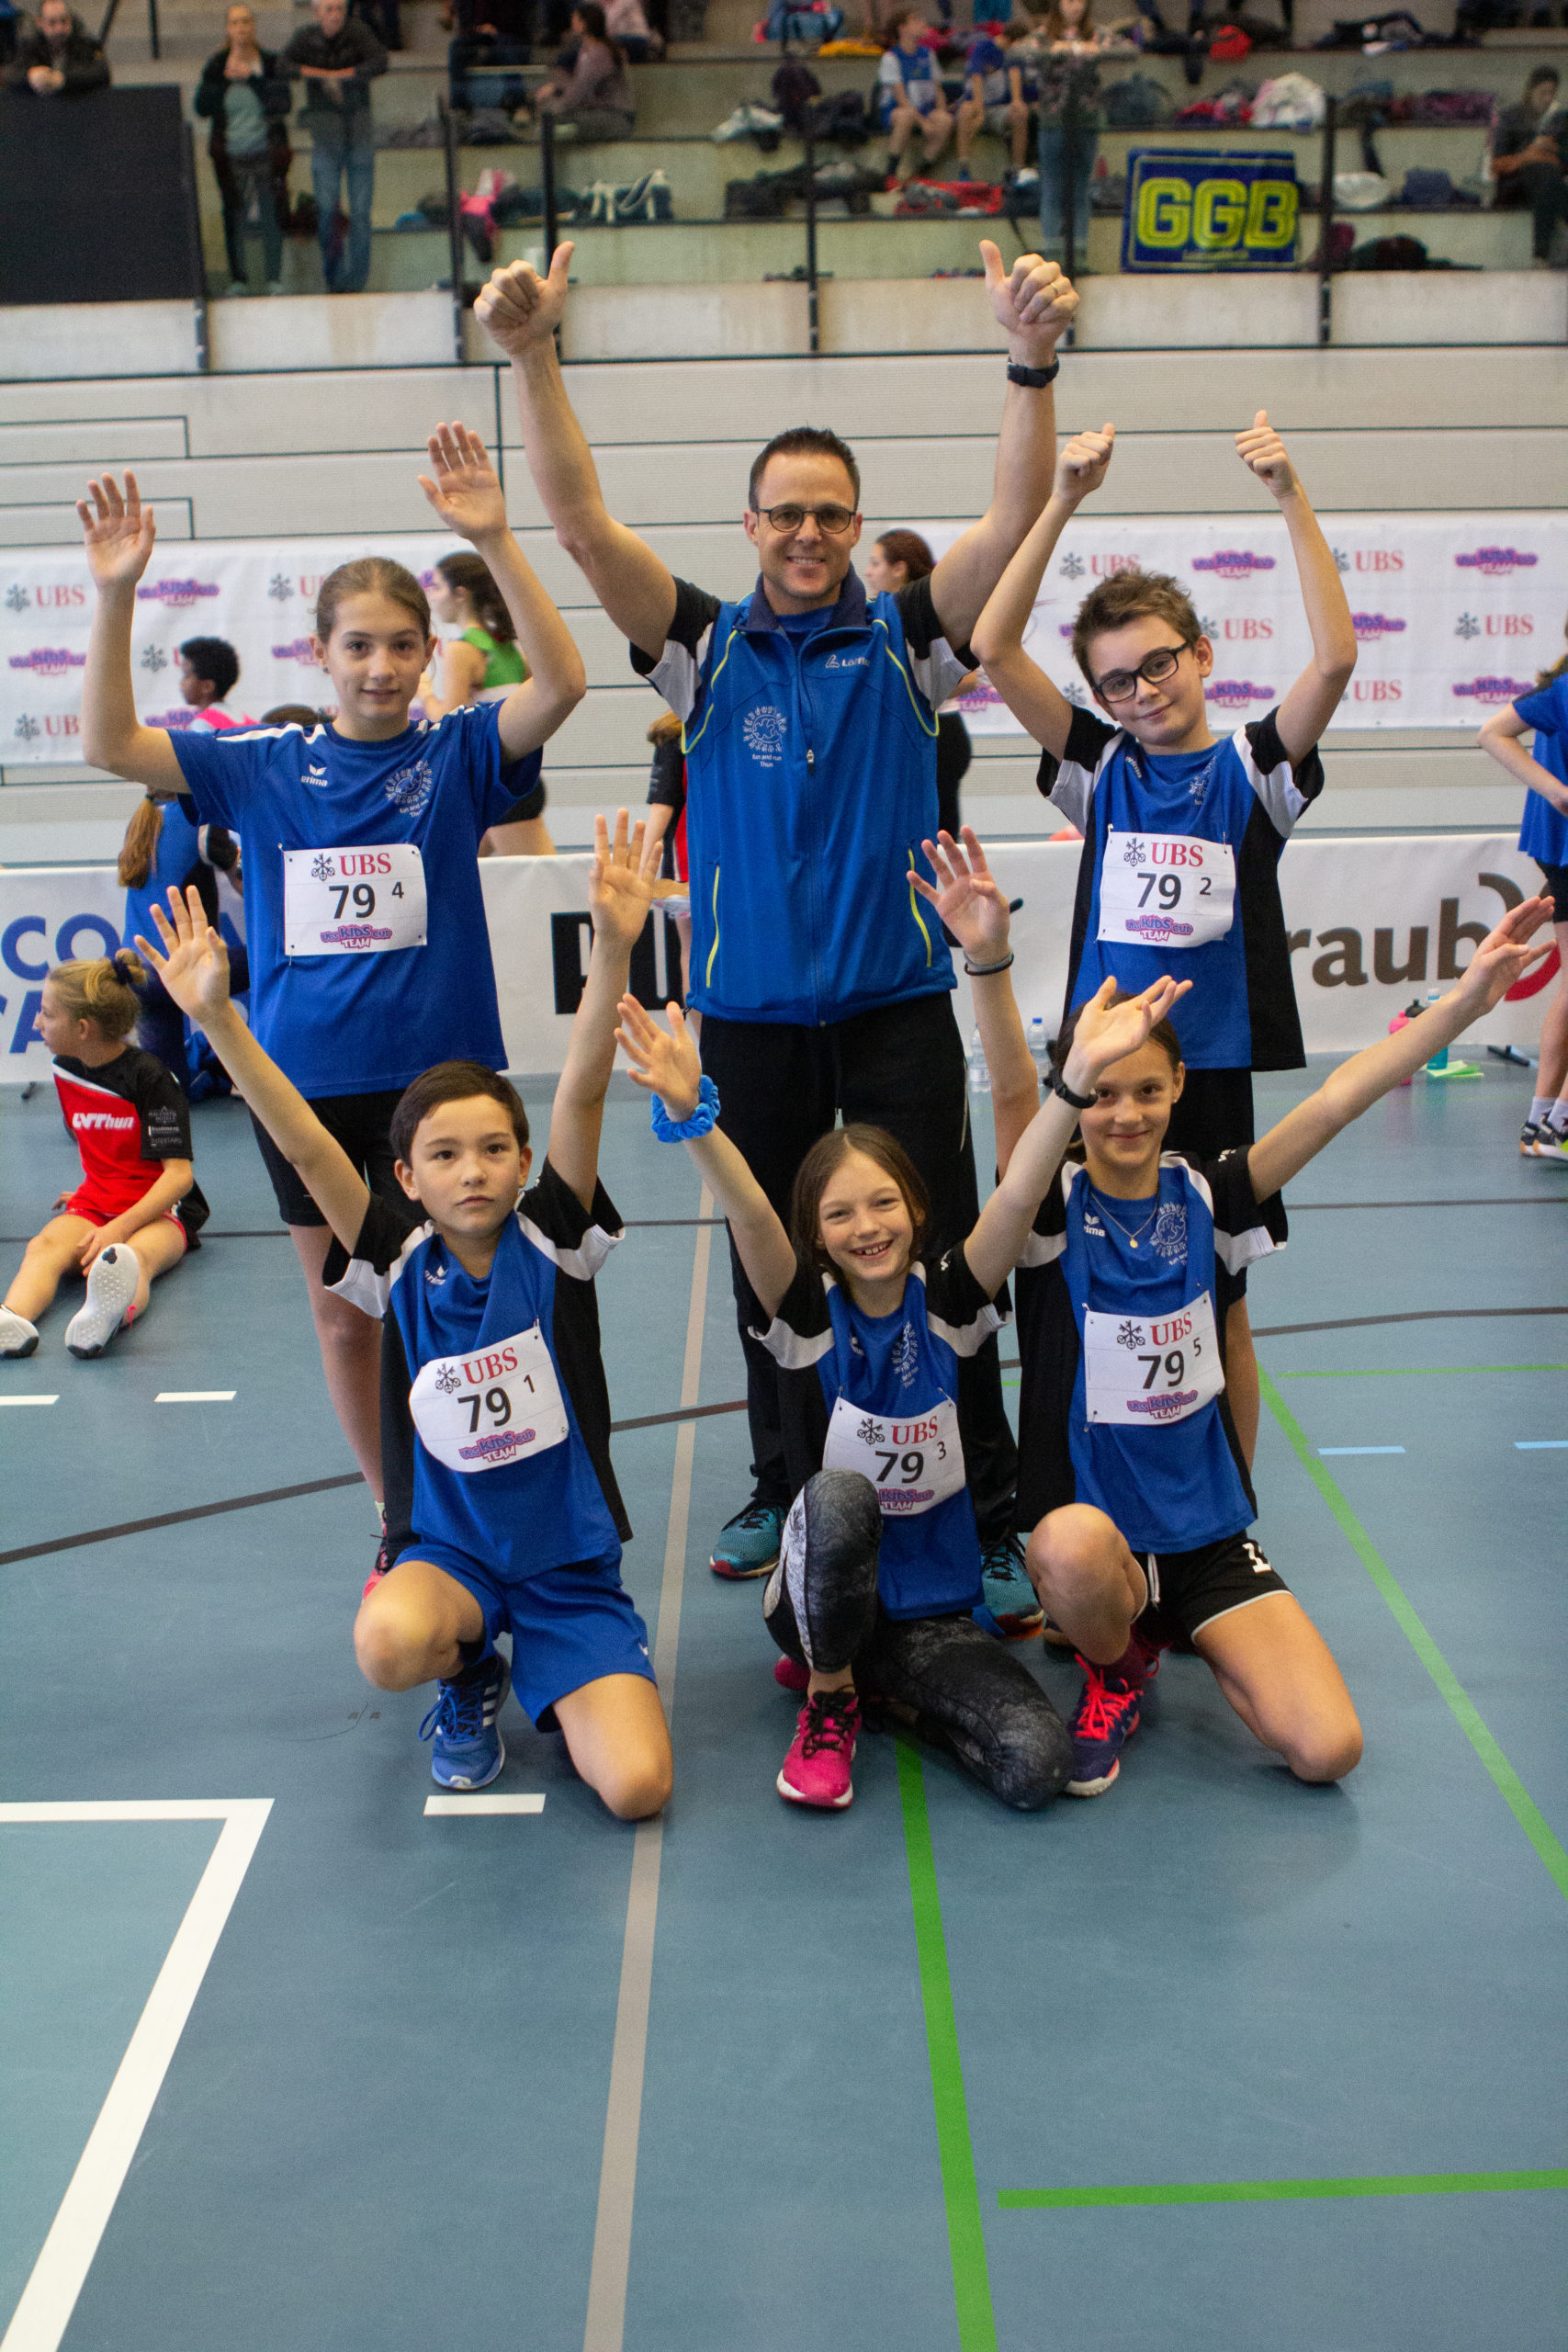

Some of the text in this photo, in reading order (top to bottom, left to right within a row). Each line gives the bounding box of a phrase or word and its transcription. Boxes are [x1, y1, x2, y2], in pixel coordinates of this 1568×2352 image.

[1138, 177, 1299, 248] GGB
[1354, 550, 1404, 572] UBS
[36, 585, 85, 607] UBS
[1224, 618, 1273, 639] UBS
[1485, 614, 1533, 636] UBS
[1354, 680, 1403, 701] UBS
[44, 715, 80, 736] UB
[300, 775, 328, 787] erima
[338, 853, 392, 876] UBS
[1151, 842, 1203, 866] UBS
[329, 881, 404, 920] 79 4
[1137, 872, 1212, 910] 79 2
[321, 925, 391, 942] UBS KIDS CUP
[1141, 916, 1171, 930] KIDS
[1172, 923, 1192, 933] CUP
[1142, 930, 1169, 941] TEAM
[343, 938, 370, 948] TEAM
[1084, 1225, 1106, 1238] rima
[1150, 1312, 1192, 1346] UBS
[461, 1347, 518, 1385] UBS
[1137, 1337, 1201, 1390] 79 5
[457, 1374, 535, 1433] 79 1
[1149, 1392, 1181, 1408] KIDS
[1150, 1407, 1181, 1419] TEAM
[891, 1416, 938, 1445] UBS
[459, 1430, 536, 1459] UBS KIDS CUP
[484, 1446, 516, 1463] TEAM
[874, 1441, 947, 1484] 79 3
[880, 1489, 915, 1500] KIDS
[882, 1500, 914, 1510] TEAM
